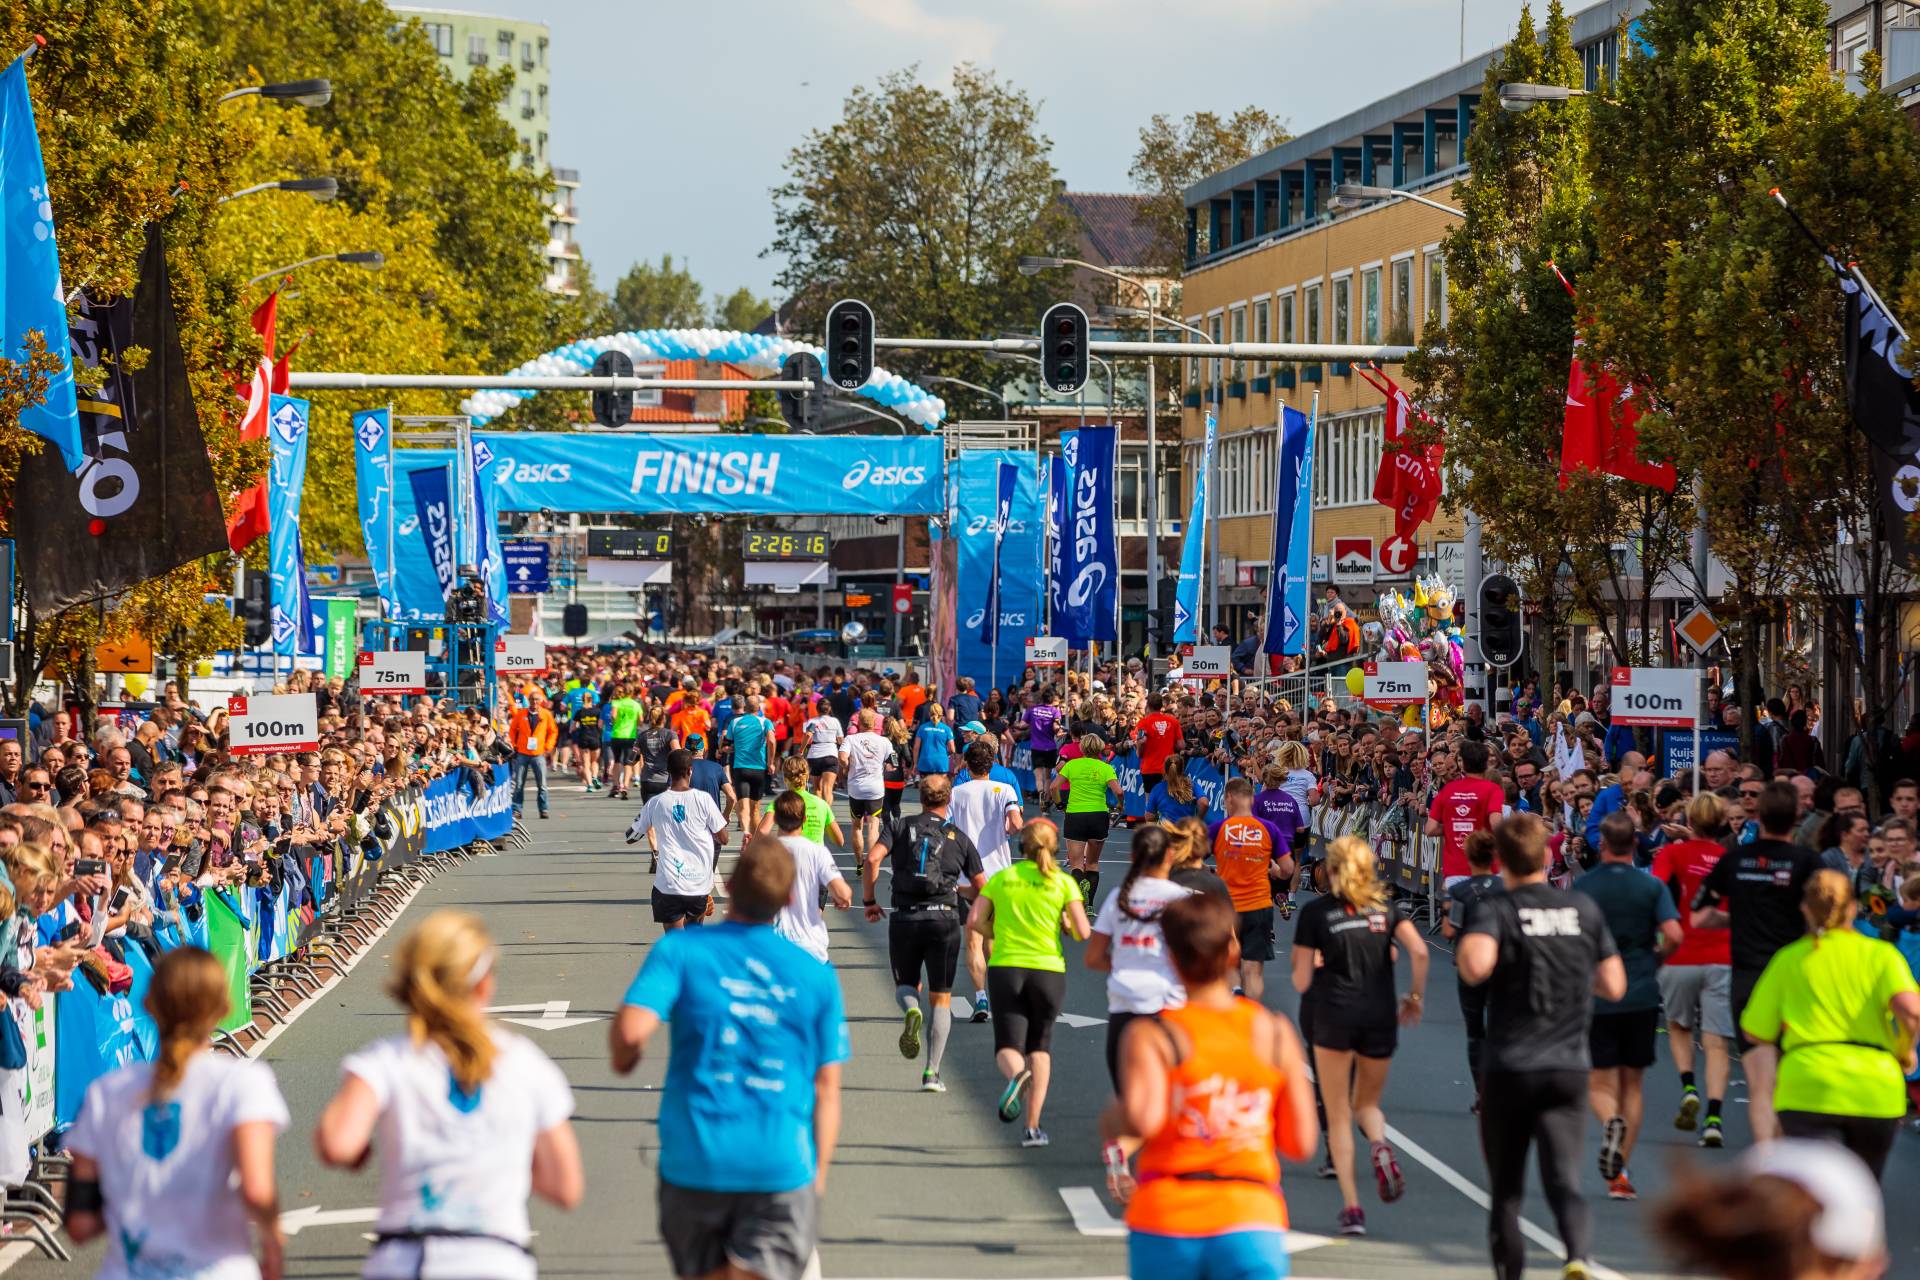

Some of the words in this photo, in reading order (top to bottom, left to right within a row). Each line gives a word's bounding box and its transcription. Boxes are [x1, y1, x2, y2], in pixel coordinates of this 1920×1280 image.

[1057, 383, 1074, 392] 08.2
[514, 463, 571, 483] asics
[631, 451, 780, 496] FINISH
[869, 466, 926, 486] asics
[750, 535, 825, 554] 2:26:16
[1336, 562, 1371, 574] Marlboro
[1033, 649, 1057, 658] 25m
[506, 656, 534, 665] 50m
[1191, 660, 1219, 670] 50m
[375, 671, 410, 683] 75m
[1377, 681, 1412, 693] 75m
[1624, 693, 1683, 710] 100m
[245, 721, 304, 737] 100m
